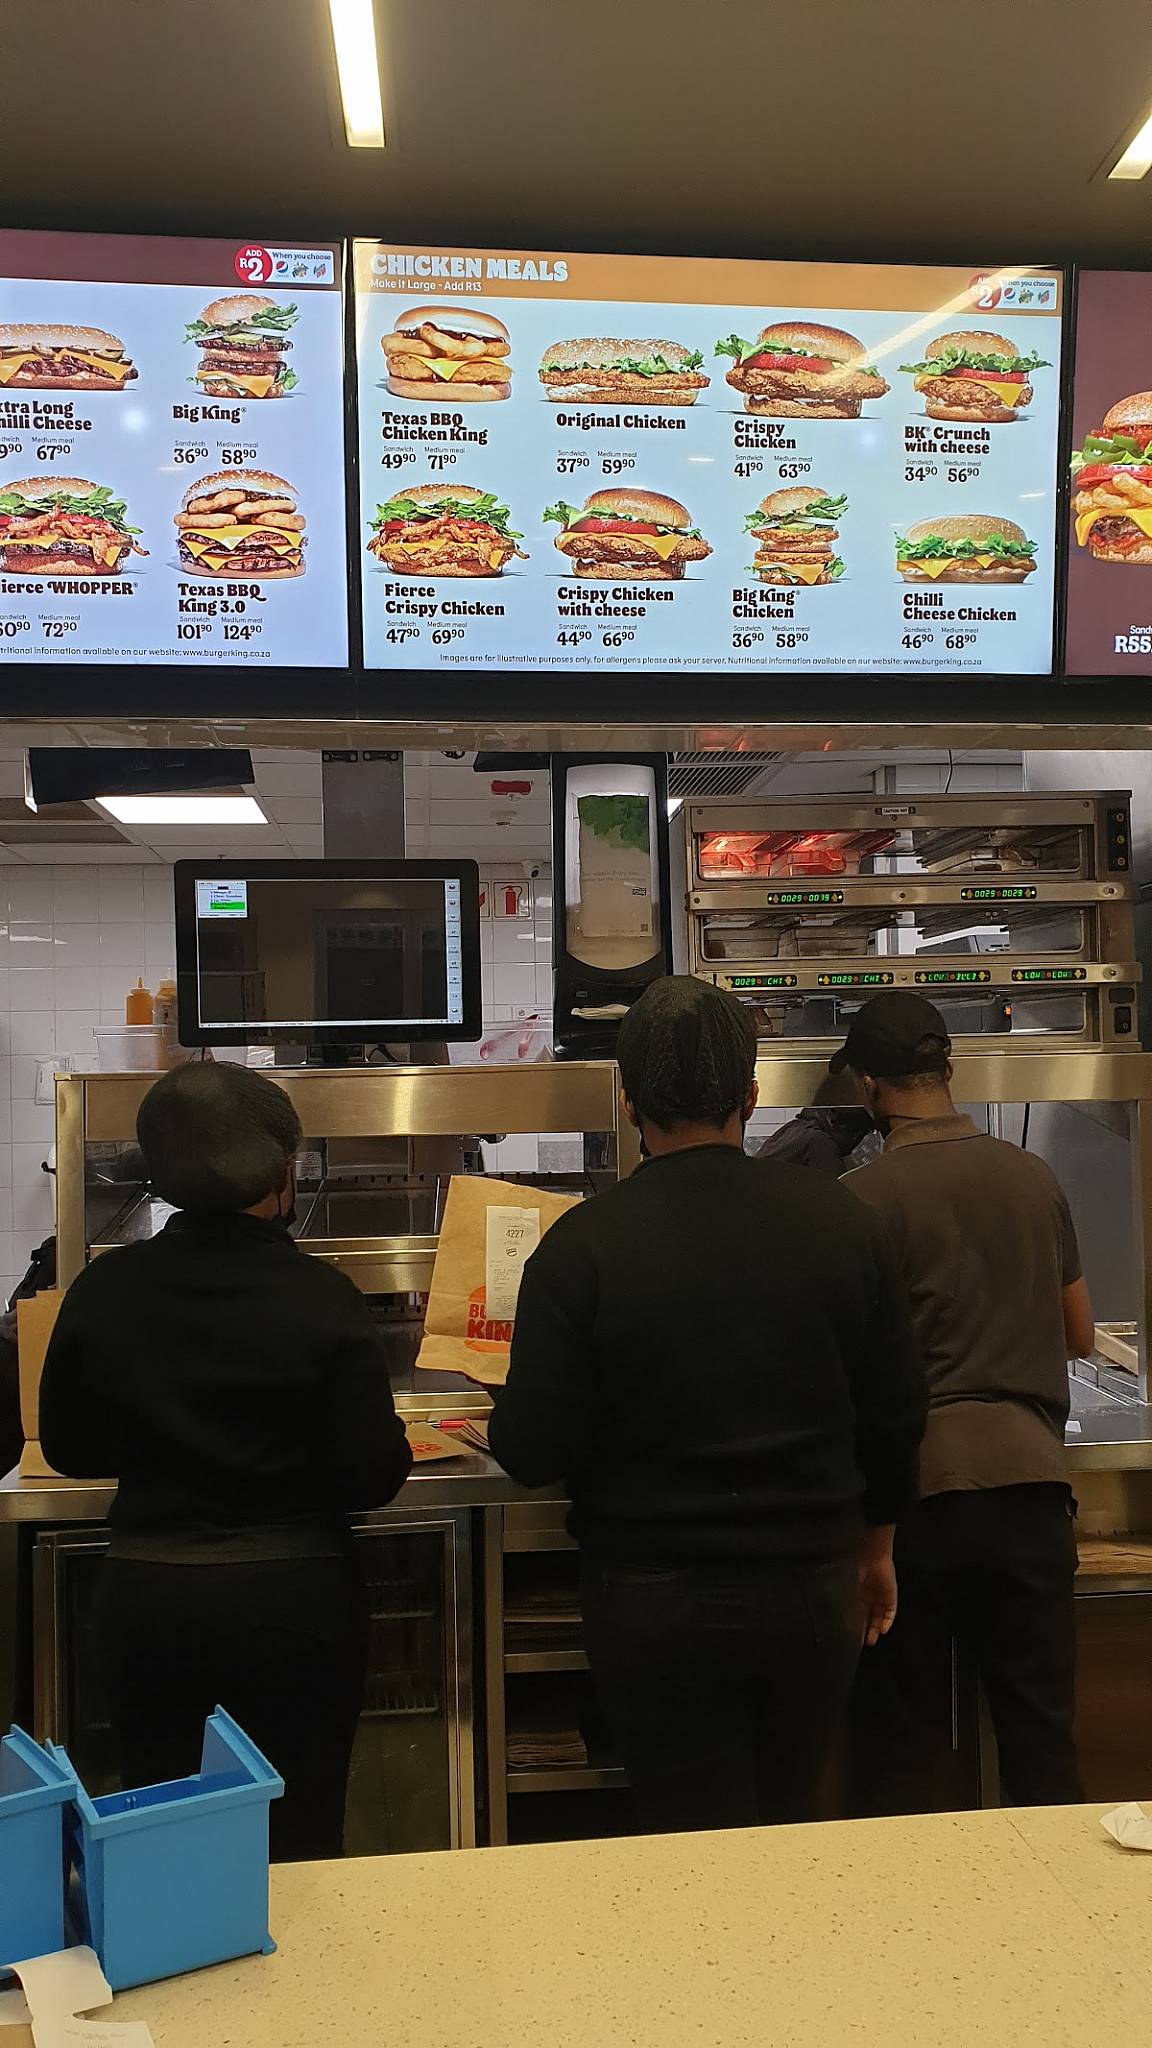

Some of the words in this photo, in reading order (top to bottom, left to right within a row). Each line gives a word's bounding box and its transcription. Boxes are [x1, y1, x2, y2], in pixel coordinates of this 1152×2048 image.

[272, 252, 293, 260] When
[371, 254, 482, 279] CHICKEN
[487, 258, 568, 282] MEALS
[371, 280, 397, 289] Make
[408, 282, 436, 291] Large
[444, 283, 463, 291] Add
[465, 283, 482, 292] R13
[33, 401, 74, 418] Long
[173, 405, 198, 422] Big
[33, 416, 92, 430] Cheese
[382, 412, 427, 426] Texas
[431, 413, 463, 429] BBQ
[557, 413, 621, 430] Original
[624, 415, 686, 430] Chicken
[382, 427, 446, 441] Chicken
[450, 427, 488, 445] King
[734, 420, 785, 438] Crispy
[934, 427, 991, 441] Crunch
[734, 435, 797, 450] Chicken
[905, 440, 937, 453] with
[940, 441, 990, 455] cheese
[37, 445, 71, 461] 6790
[174, 448, 209, 464] 3690
[221, 449, 257, 465] 5890
[381, 453, 417, 469] 4990
[427, 454, 457, 470] 7190
[557, 458, 590, 473] 3790
[602, 459, 636, 474] 5990
[734, 462, 764, 477] 4190
[778, 463, 811, 479] 6390
[904, 467, 938, 482] 3490
[947, 468, 980, 483] 5690
[178, 584, 224, 597] Texas
[227, 584, 267, 602] BBQ
[385, 584, 435, 598] Fierce
[557, 587, 609, 603] Crispy
[612, 588, 674, 602] Chicken
[732, 589, 757, 605] Big
[903, 593, 944, 607] Chilli
[178, 600, 217, 617] King
[220, 600, 246, 613] 3.0
[385, 601, 437, 618] Crispy
[441, 602, 505, 616] Chicken
[558, 603, 592, 617] with
[595, 604, 647, 617] cheese
[732, 605, 795, 619] Chicken
[903, 607, 955, 621] Cheese
[957, 608, 1017, 622] Chicken
[42, 622, 78, 638] 7290
[177, 624, 212, 641] 10190
[223, 625, 263, 641] 12490
[386, 628, 420, 644] 4790
[432, 629, 465, 645] 6990
[1130, 625, 1152, 635] Sand
[557, 631, 592, 646] 4490
[602, 631, 635, 647] 6690
[732, 632, 764, 648] 3690
[776, 633, 809, 649] 5890
[902, 633, 934, 649] 4690
[945, 634, 977, 650] 6890
[34, 647, 81, 655] information
[83, 647, 119, 656] available
[440, 654, 470, 663] Images
[498, 655, 537, 663] illustrative
[540, 656, 574, 665] purposes
[594, 655, 605, 663] for
[606, 656, 640, 665] allergens
[642, 656, 666, 665] please
[668, 656, 682, 664] ask
[683, 658, 700, 666] your
[728, 657, 768, 665] Nutritional
[769, 657, 811, 665] information
[813, 657, 846, 666] available
[507, 1229, 524, 1239] 4227
